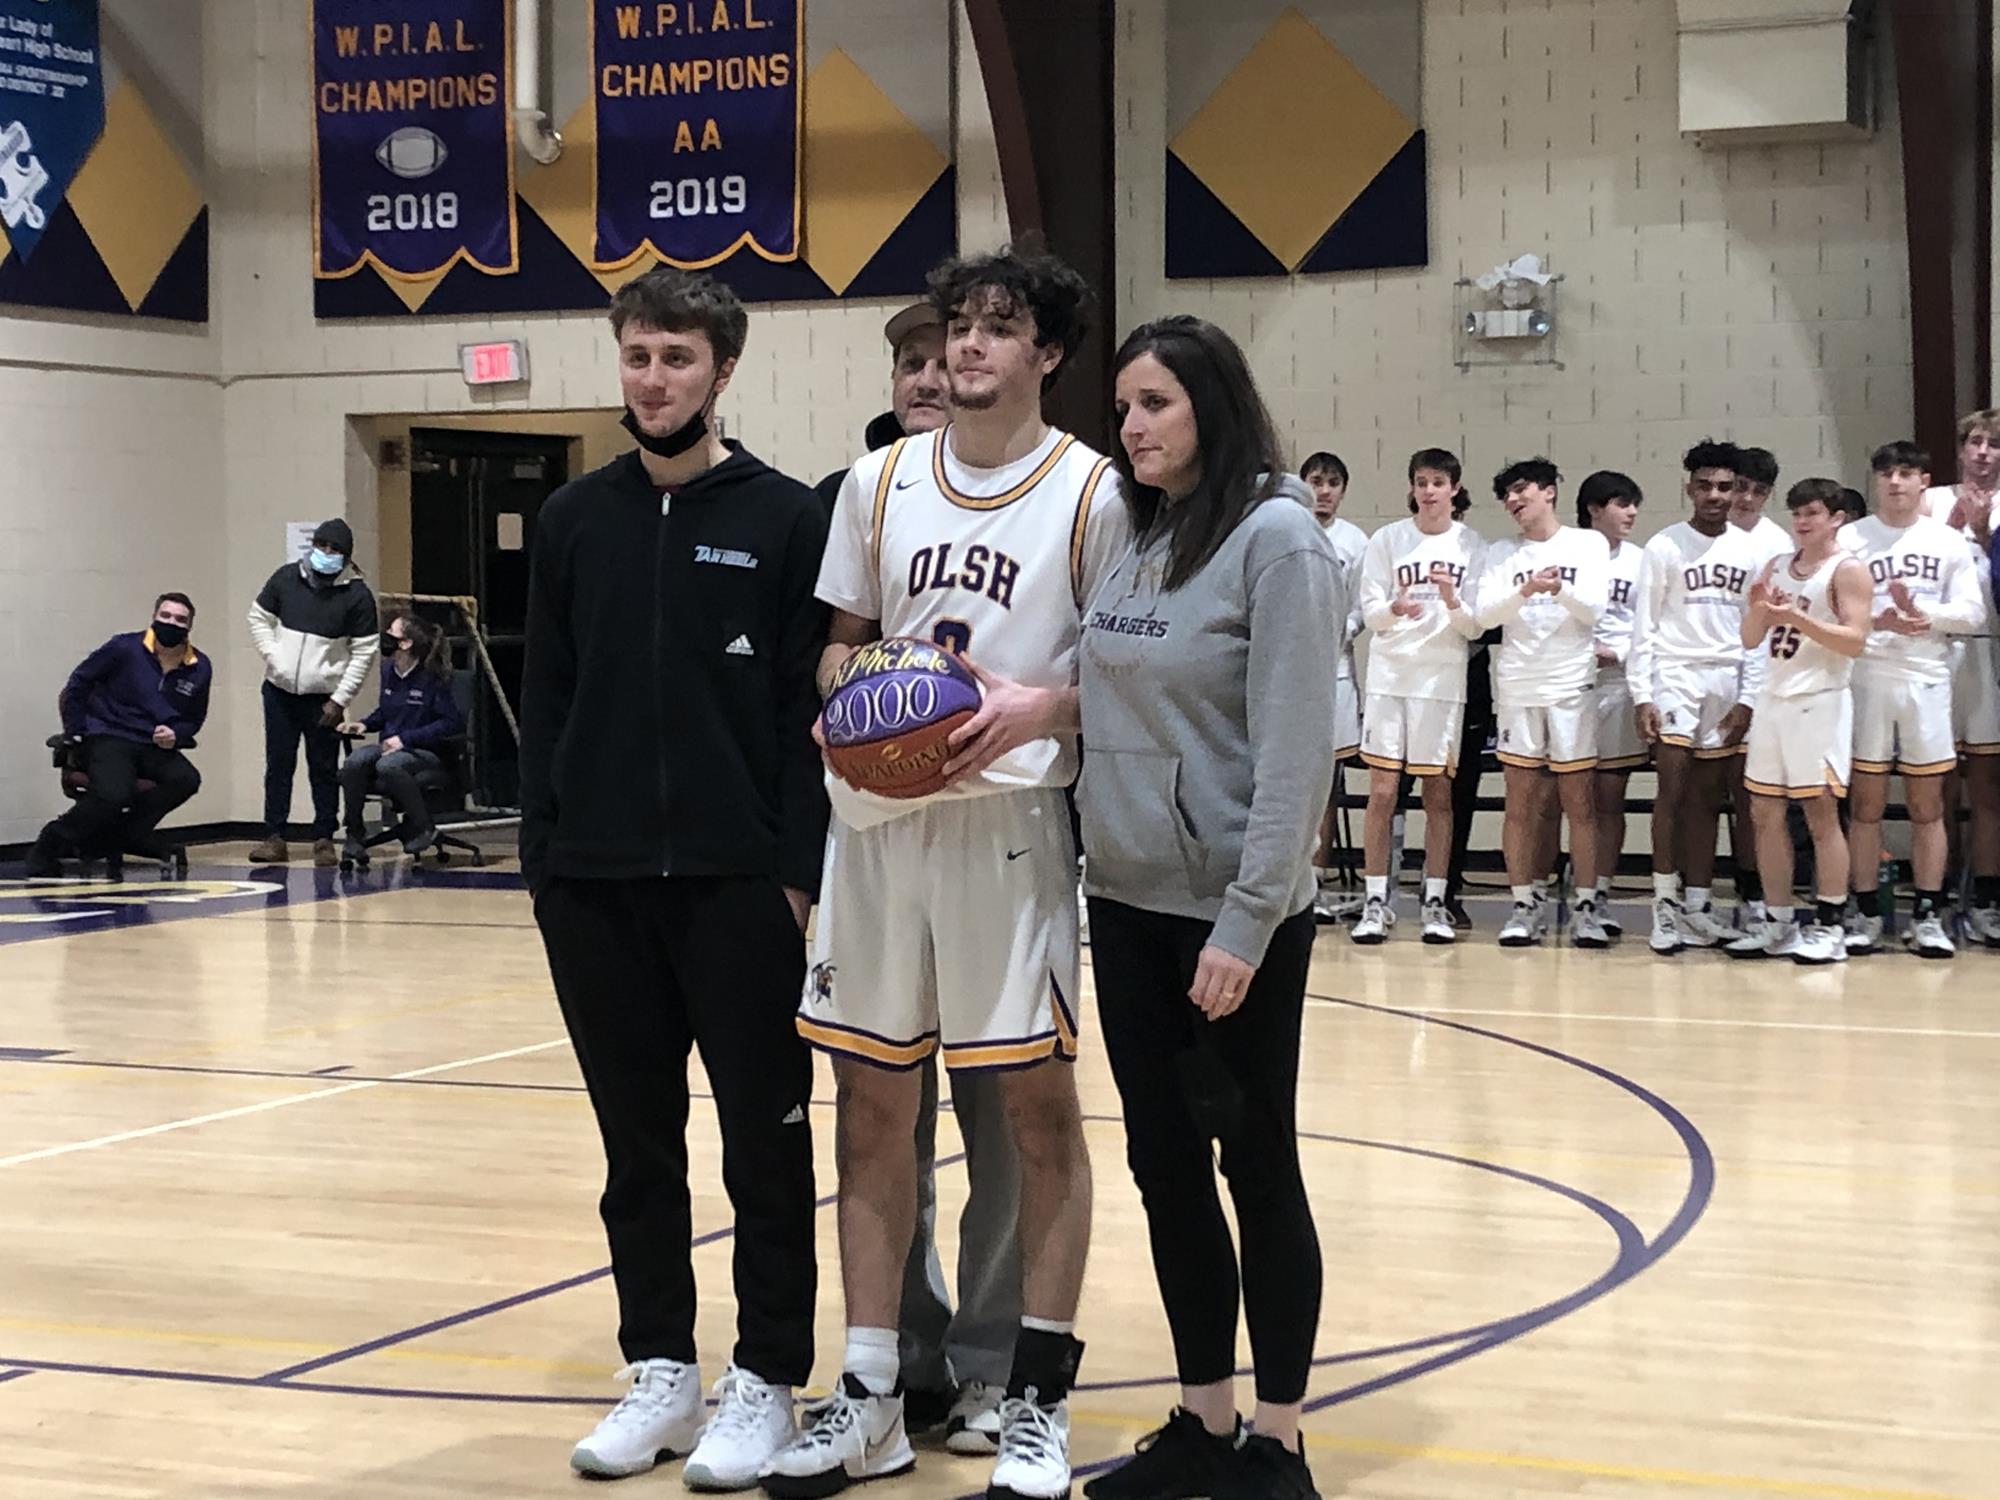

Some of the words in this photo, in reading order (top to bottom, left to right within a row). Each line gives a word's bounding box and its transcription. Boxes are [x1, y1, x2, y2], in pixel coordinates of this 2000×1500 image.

[9, 15, 37, 37] Lady
[41, 22, 53, 38] of
[335, 18, 484, 58] W.P.I.A.L.
[616, 0, 774, 39] W.P.I.A.L.
[24, 38, 51, 59] High
[53, 43, 94, 64] School
[320, 72, 498, 114] CHAMPIONS
[602, 52, 790, 97] CHAMPIONS
[367, 192, 459, 231] 2018
[649, 175, 746, 219] 2019
[908, 542, 1021, 610] OLSH
[1684, 563, 1747, 594] OLSH
[1868, 553, 1942, 584] OLSH
[1770, 624, 1801, 660] 25
[826, 674, 940, 742] 2000
